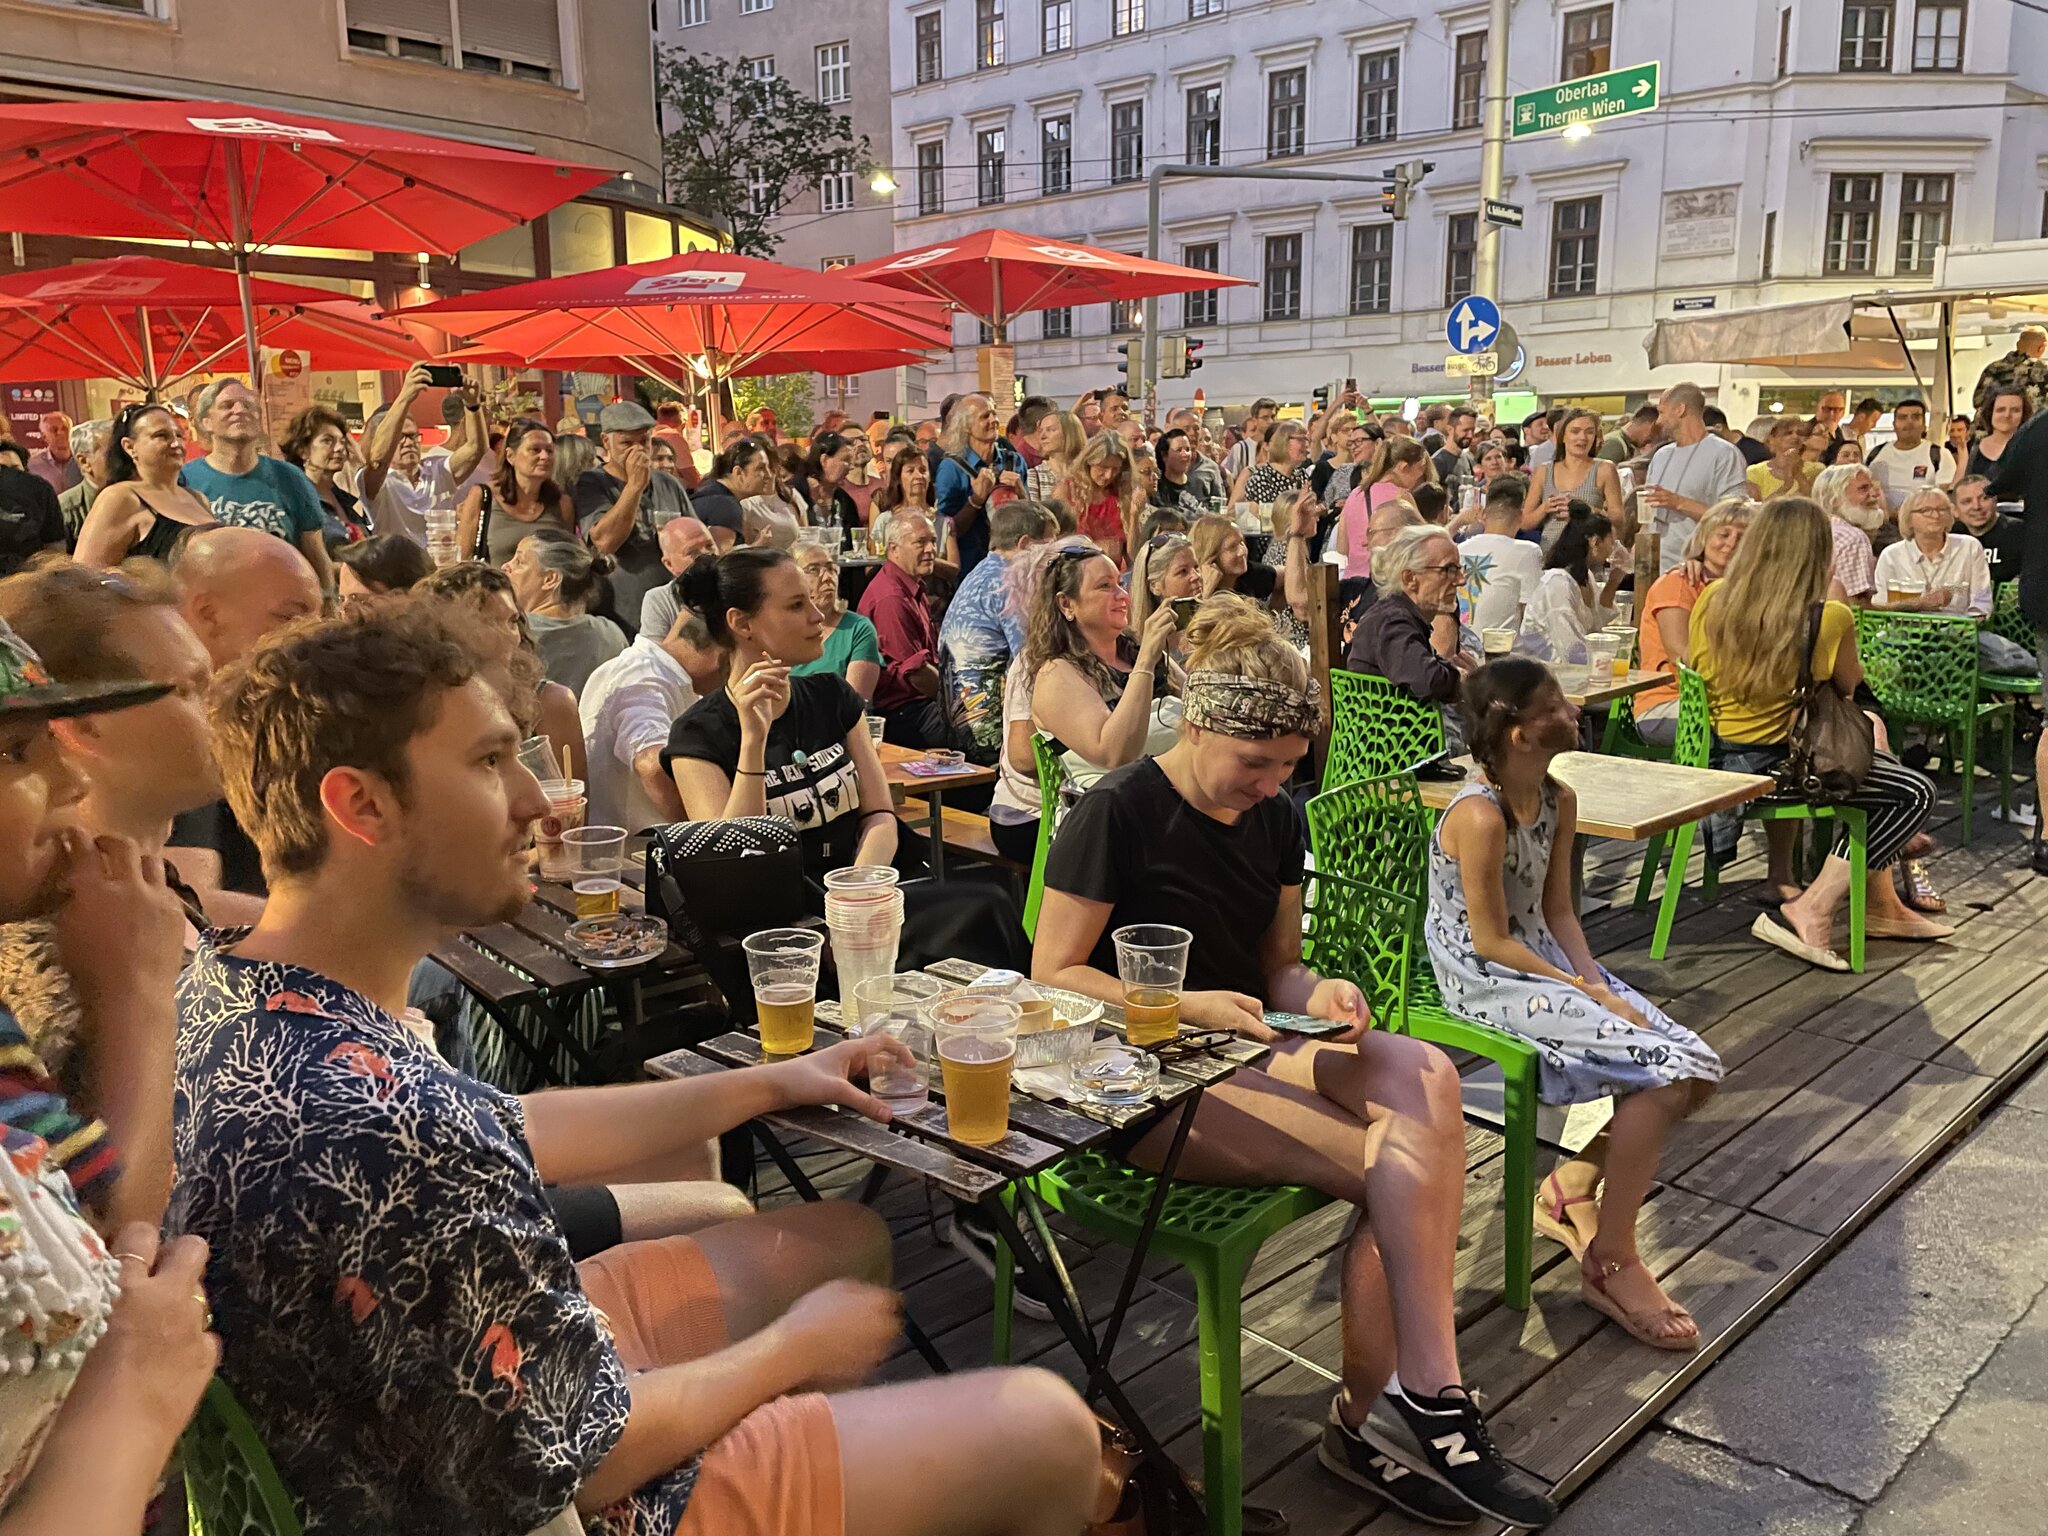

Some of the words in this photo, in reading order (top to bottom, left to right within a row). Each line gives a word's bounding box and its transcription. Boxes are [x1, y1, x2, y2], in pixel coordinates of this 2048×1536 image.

[1555, 81, 1608, 104] Oberlaa
[1538, 108, 1588, 128] Therme
[1592, 98, 1625, 118] Wien
[1411, 363, 1444, 373] Besser
[1535, 355, 1574, 366] Besser
[1575, 352, 1612, 365] Leben
[1431, 1431, 1479, 1467] N
[1369, 1454, 1410, 1482] N
